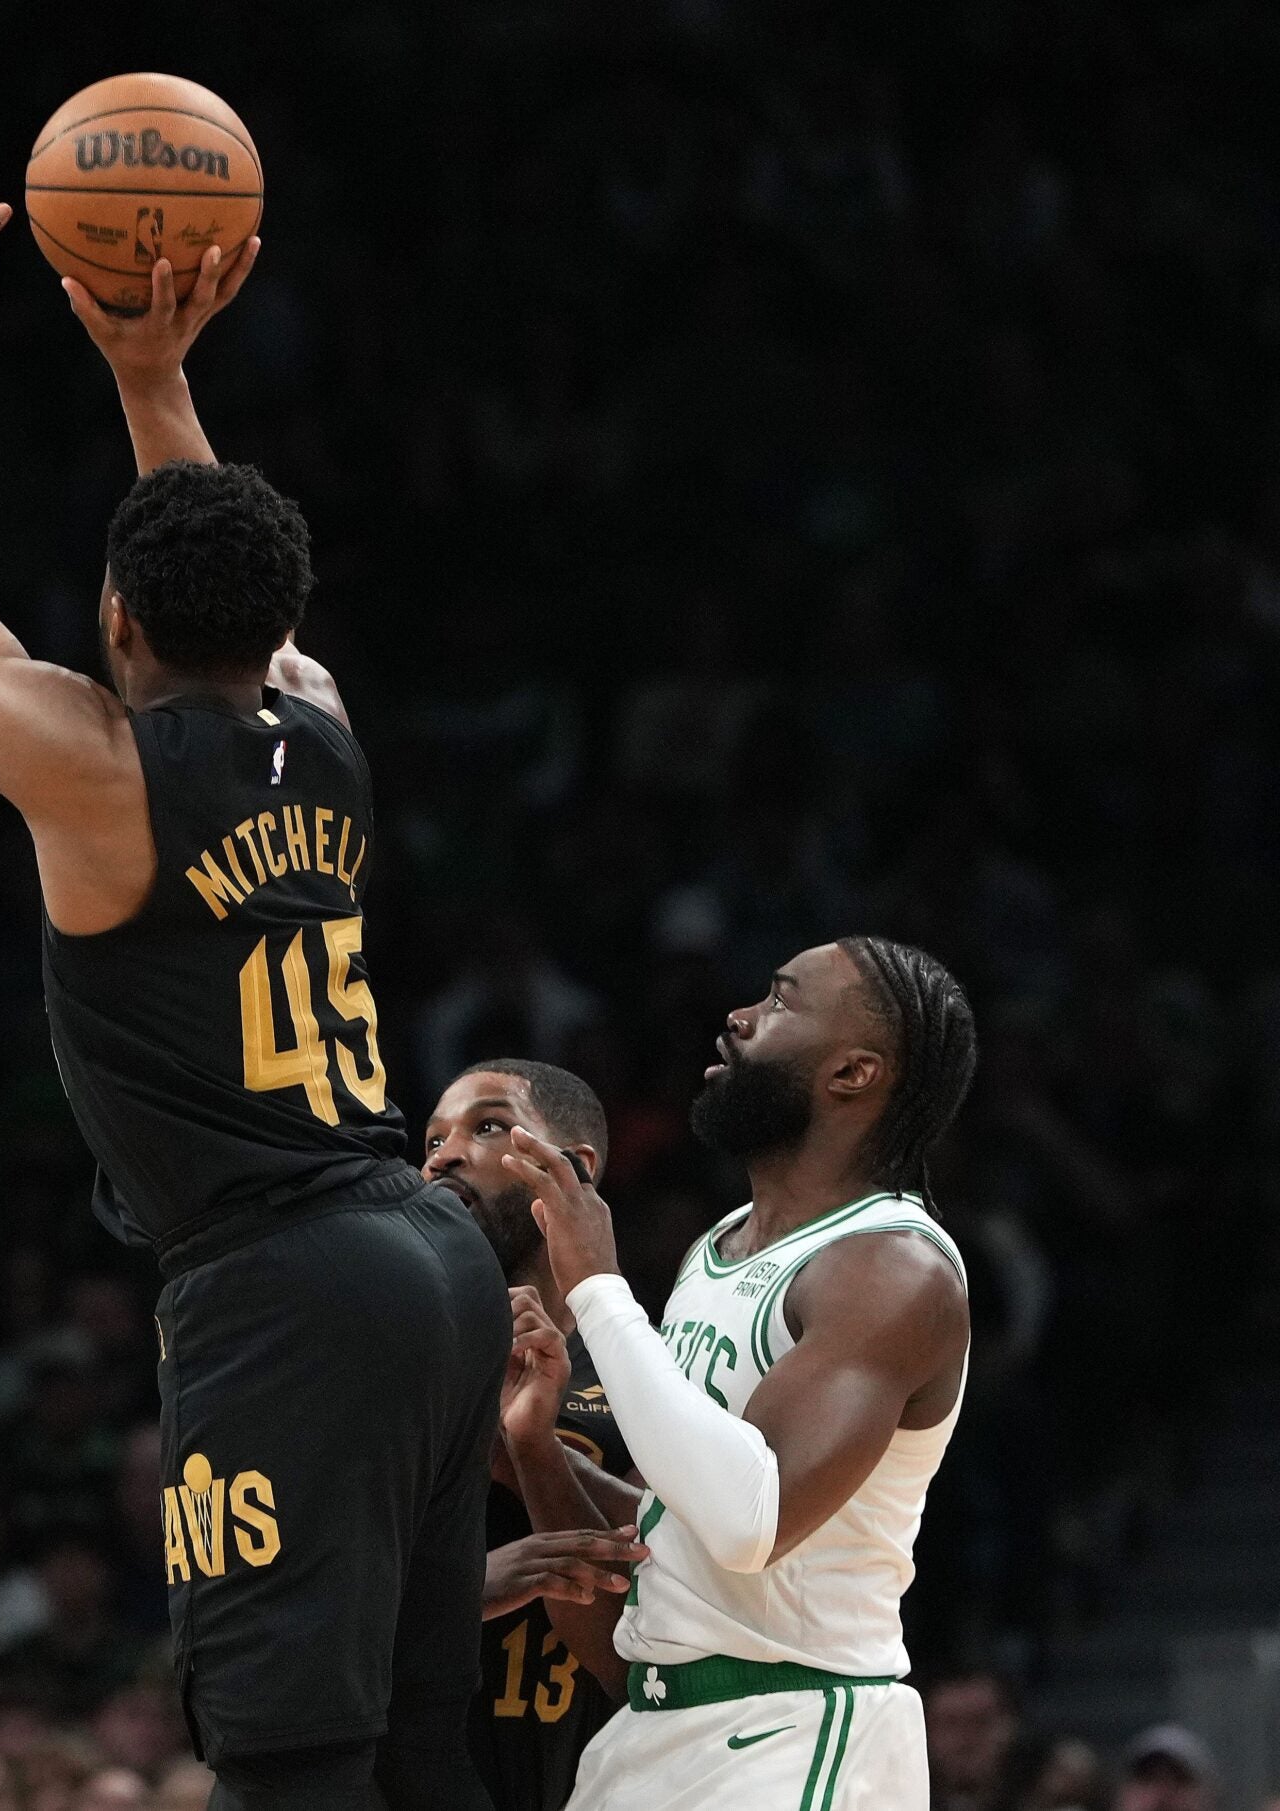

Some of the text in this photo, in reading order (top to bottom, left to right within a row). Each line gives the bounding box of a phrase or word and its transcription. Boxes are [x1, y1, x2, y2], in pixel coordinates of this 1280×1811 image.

[75, 128, 231, 181] Wilson
[238, 915, 387, 1129] 45
[731, 1281, 766, 1300] PRINT
[744, 1261, 781, 1283] VISTA
[566, 1401, 613, 1415] CLIFF
[160, 1453, 282, 1585] AVS
[494, 1618, 580, 1724] 13
